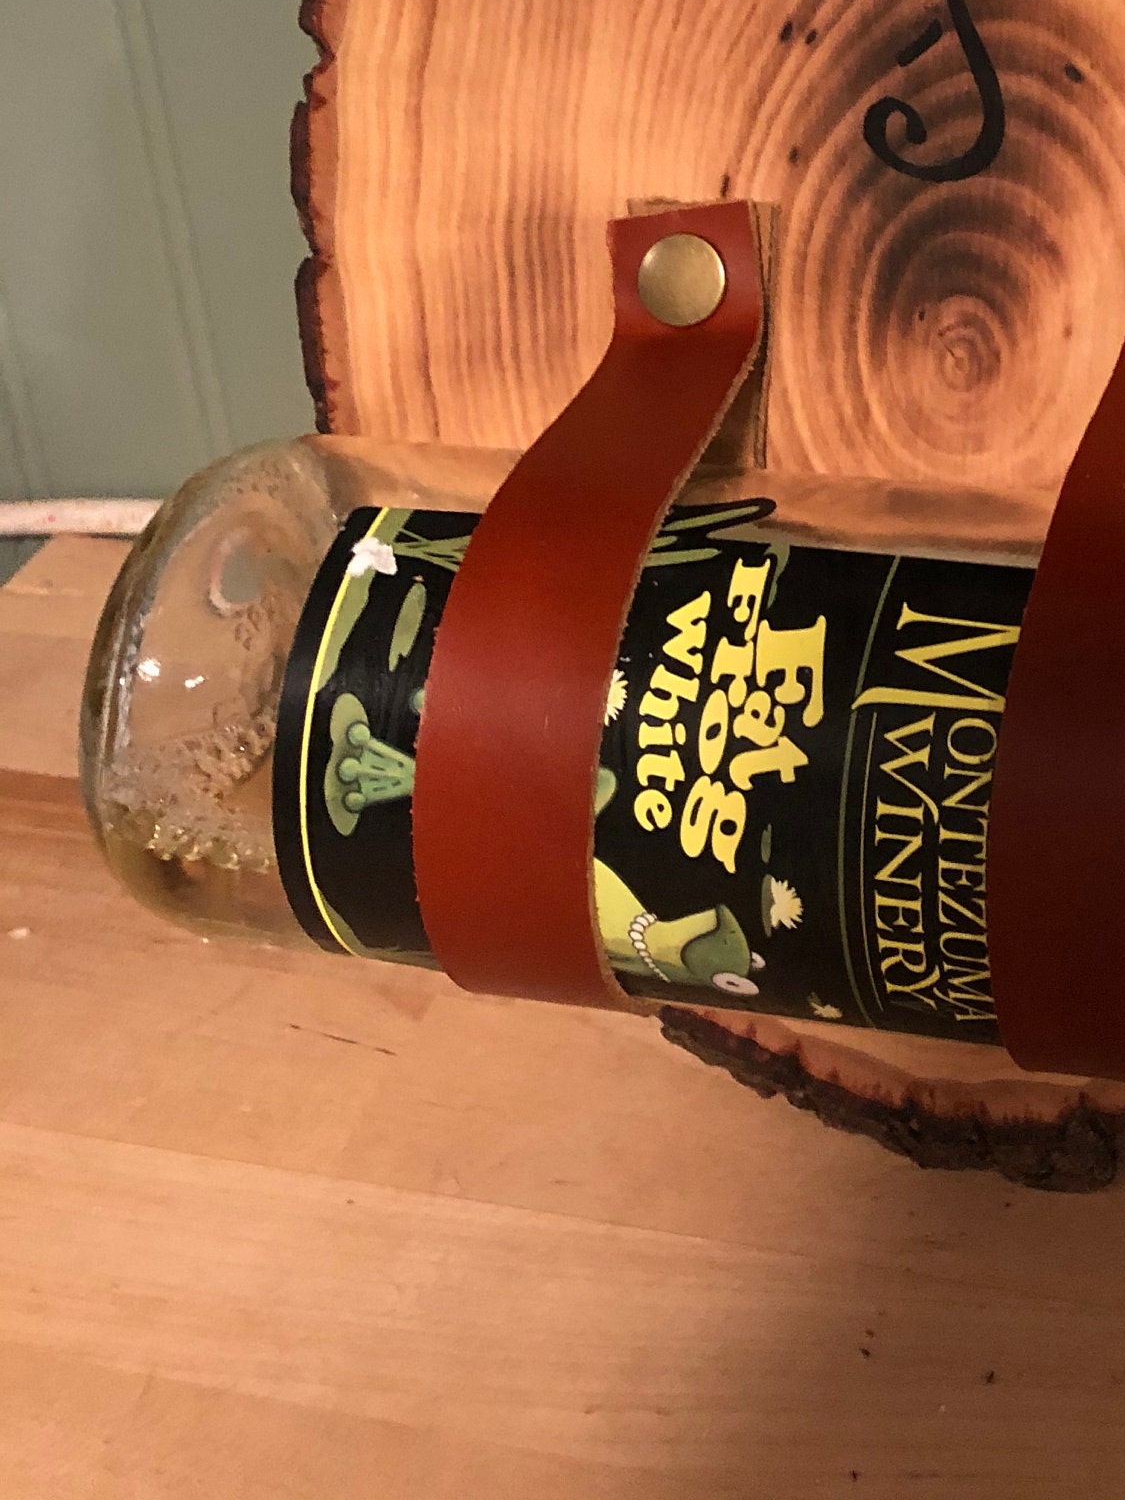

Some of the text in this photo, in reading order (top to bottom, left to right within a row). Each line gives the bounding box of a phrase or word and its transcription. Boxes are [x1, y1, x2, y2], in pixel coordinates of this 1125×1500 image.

[679, 556, 771, 874] Frog
[727, 614, 828, 791] Fat
[850, 602, 1021, 1023] MONTEZUMA
[873, 711, 941, 1012] WINERY
